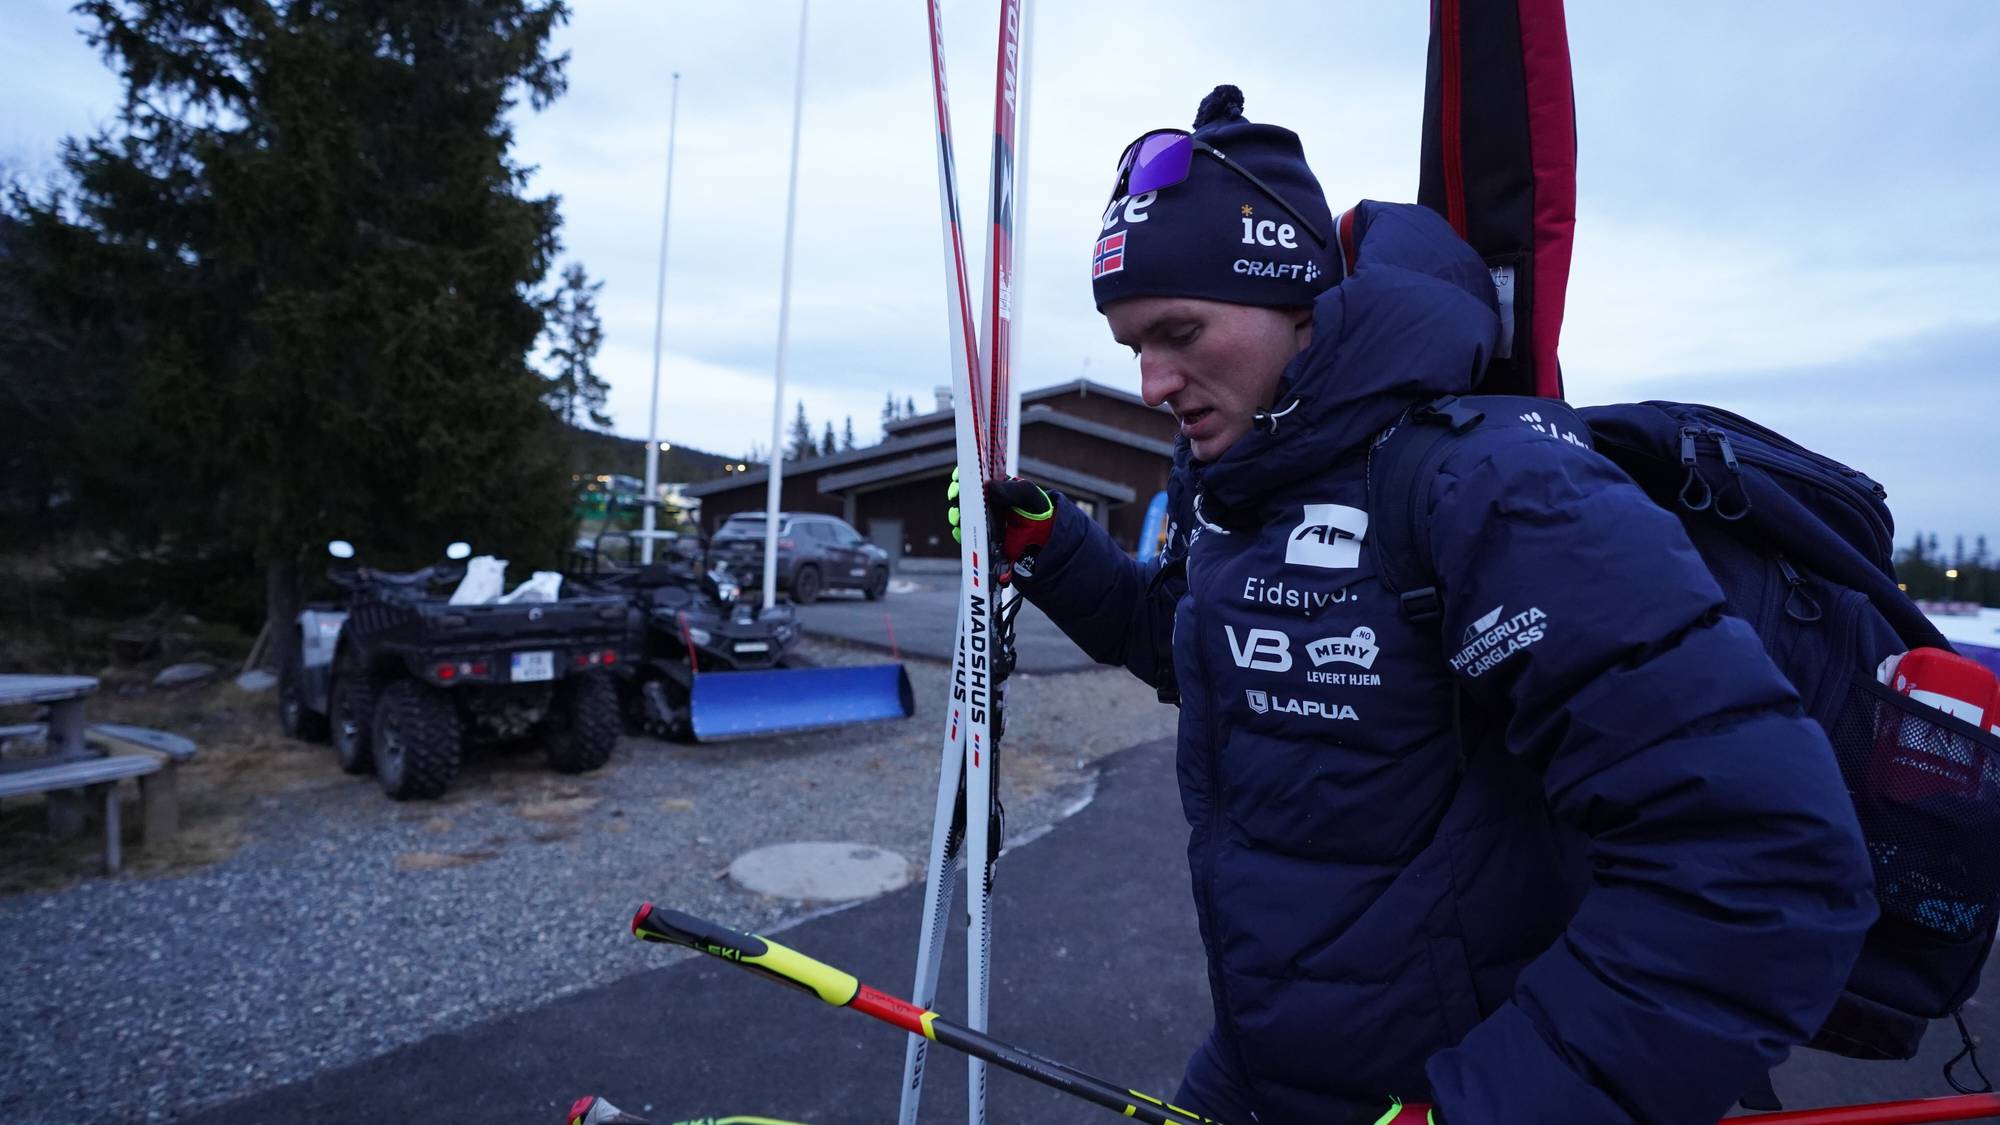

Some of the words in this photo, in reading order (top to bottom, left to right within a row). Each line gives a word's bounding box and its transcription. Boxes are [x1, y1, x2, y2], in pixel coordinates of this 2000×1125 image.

[1241, 206, 1298, 249] ice
[1233, 259, 1304, 279] CRAFT
[1224, 625, 1293, 673] VB
[1315, 643, 1370, 659] MENY
[1450, 607, 1547, 670] HURTIGRUTA
[970, 594, 986, 725] MADSHUS
[1307, 671, 1347, 684] LEVERT
[1349, 674, 1381, 686] HJEM
[1272, 696, 1359, 720] LAPUA
